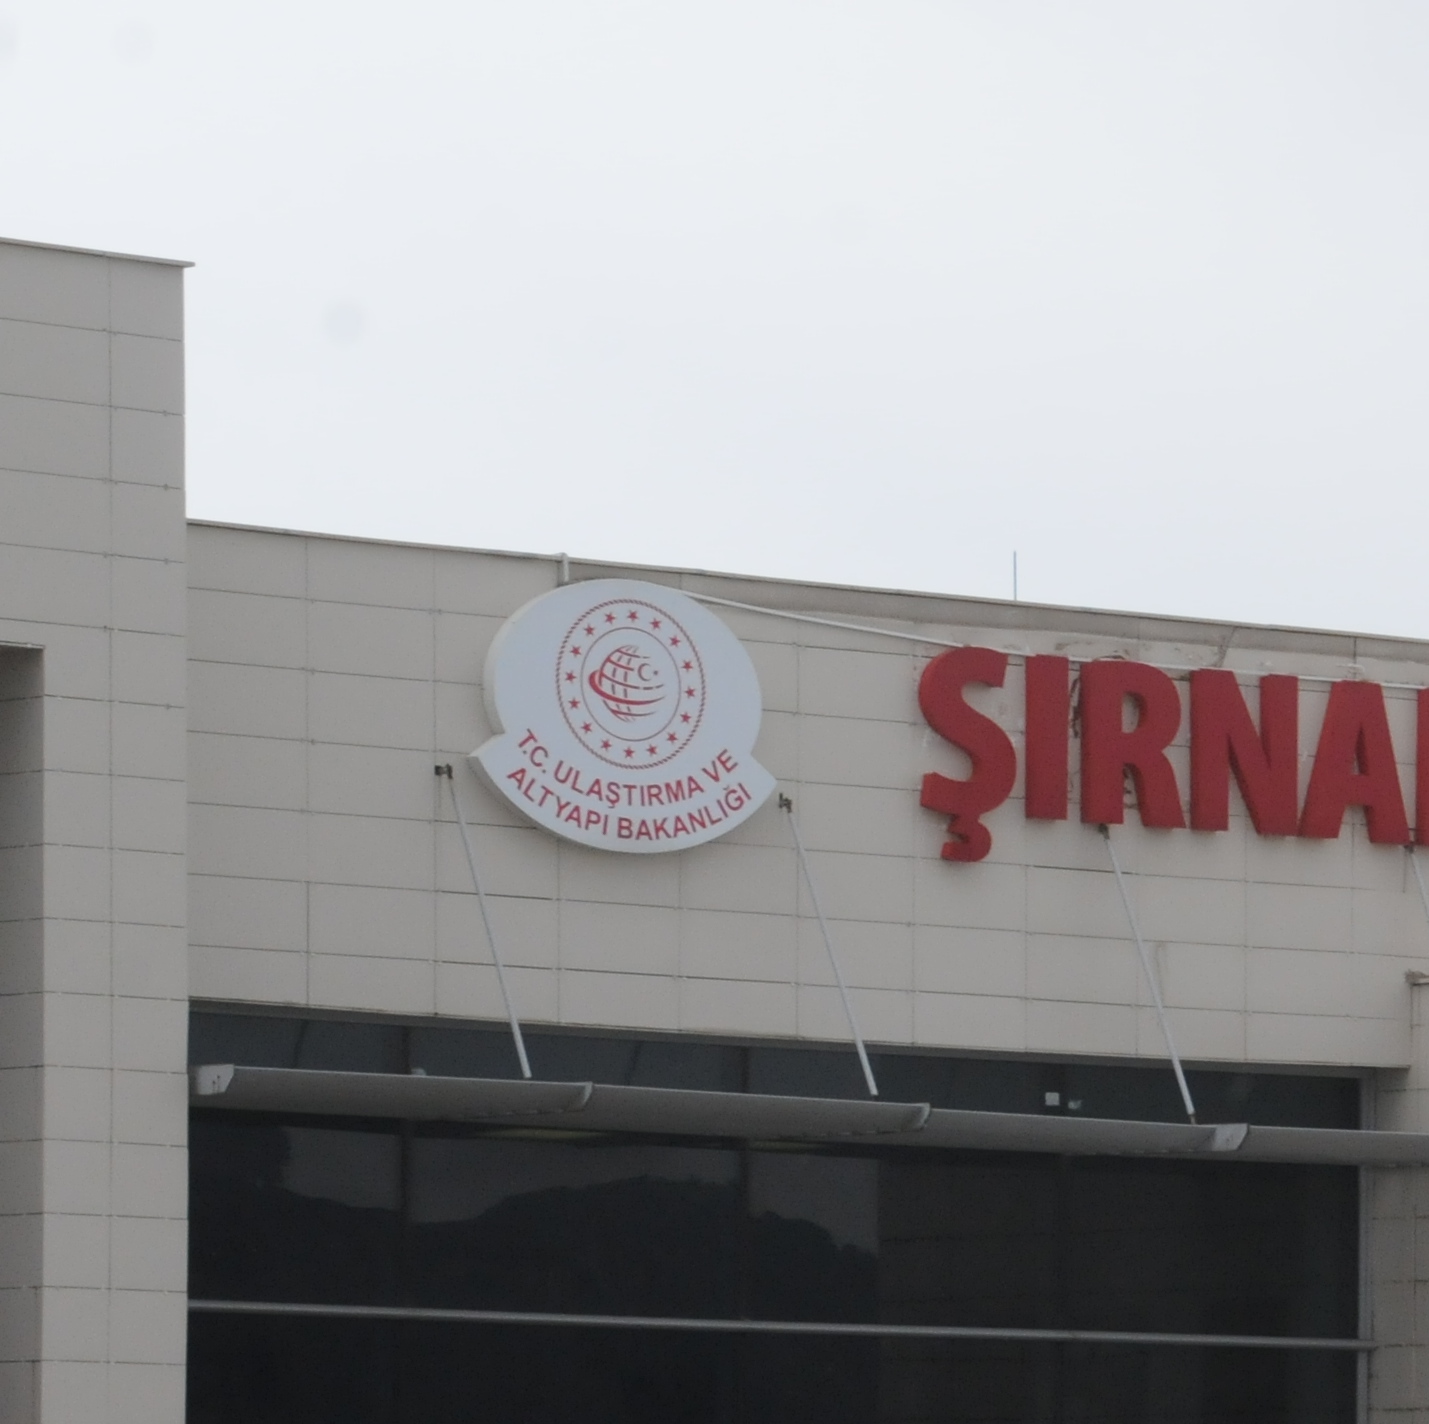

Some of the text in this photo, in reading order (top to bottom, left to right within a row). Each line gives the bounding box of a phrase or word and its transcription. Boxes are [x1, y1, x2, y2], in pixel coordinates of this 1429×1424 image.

[506, 767, 752, 841] ALTYAPI BAKANLIĞI
[516, 728, 739, 809] T.C. ULAŞTIRMA VE
